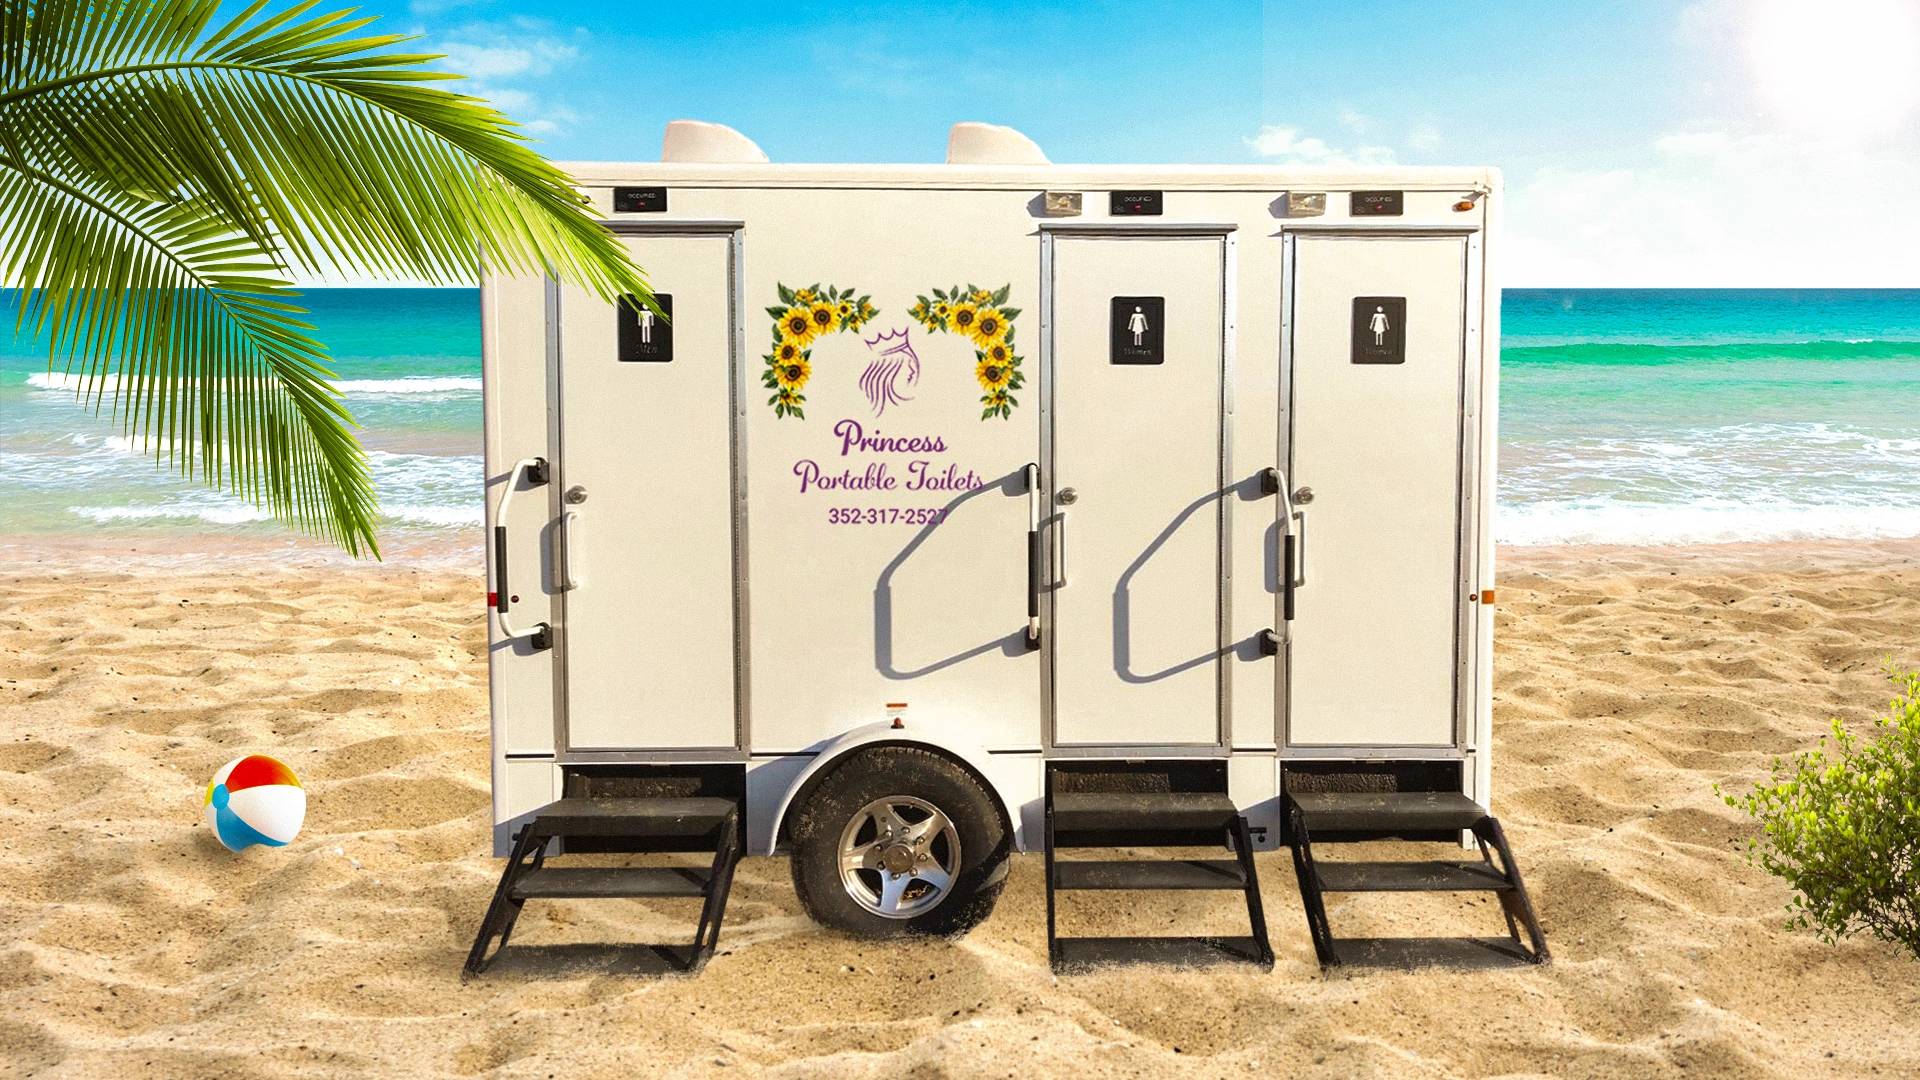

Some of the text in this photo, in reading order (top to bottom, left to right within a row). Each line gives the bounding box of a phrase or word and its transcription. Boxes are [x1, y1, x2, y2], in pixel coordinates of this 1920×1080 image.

[833, 419, 948, 456] Princess
[793, 459, 984, 493] Portable Toilets
[828, 507, 949, 525] 352-317-2527
